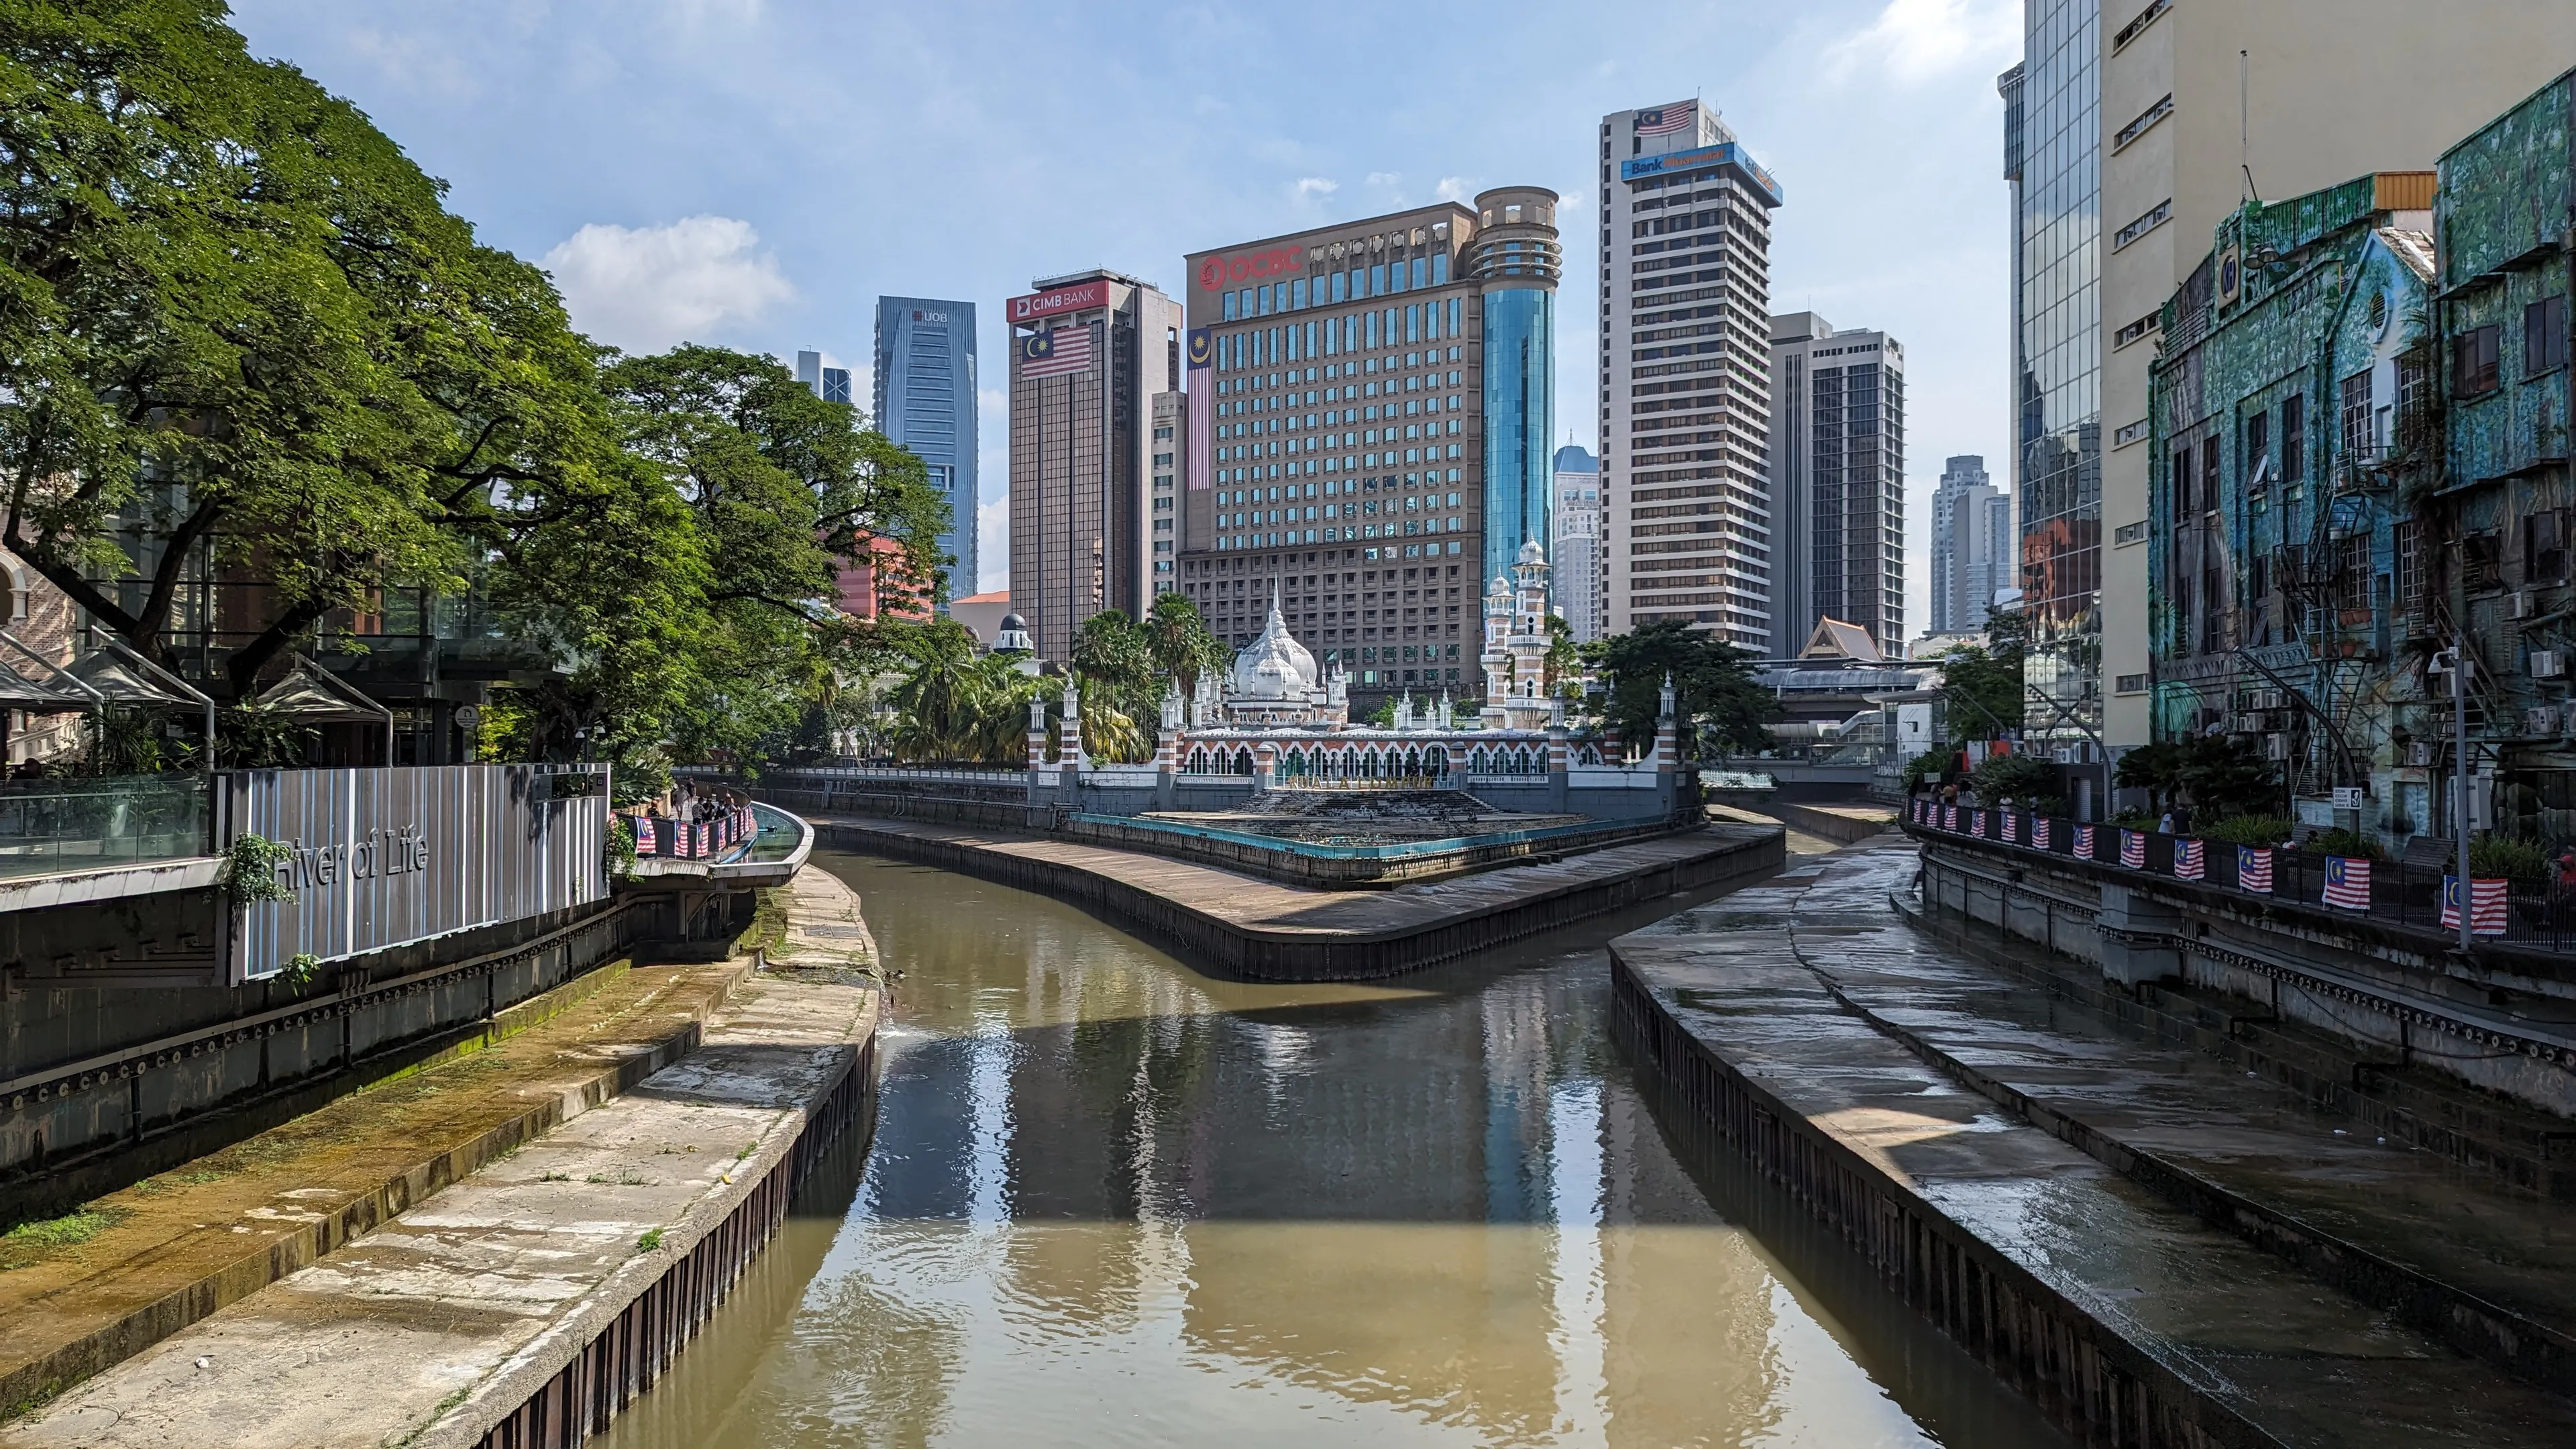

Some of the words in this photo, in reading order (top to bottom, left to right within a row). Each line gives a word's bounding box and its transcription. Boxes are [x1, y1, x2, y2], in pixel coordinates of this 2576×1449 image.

[1631, 158, 1662, 174] Bank
[1230, 245, 1303, 282] OCBC
[2222, 259, 2235, 294] KH
[1032, 294, 1062, 311] CIMB
[1064, 288, 1095, 305] BANK
[924, 311, 947, 323] UOB
[1289, 775, 1351, 790] KUALA
[1358, 775, 1434, 790] LUMPUR
[273, 838, 345, 890] River
[352, 827, 379, 879] of
[385, 824, 429, 875] Life
